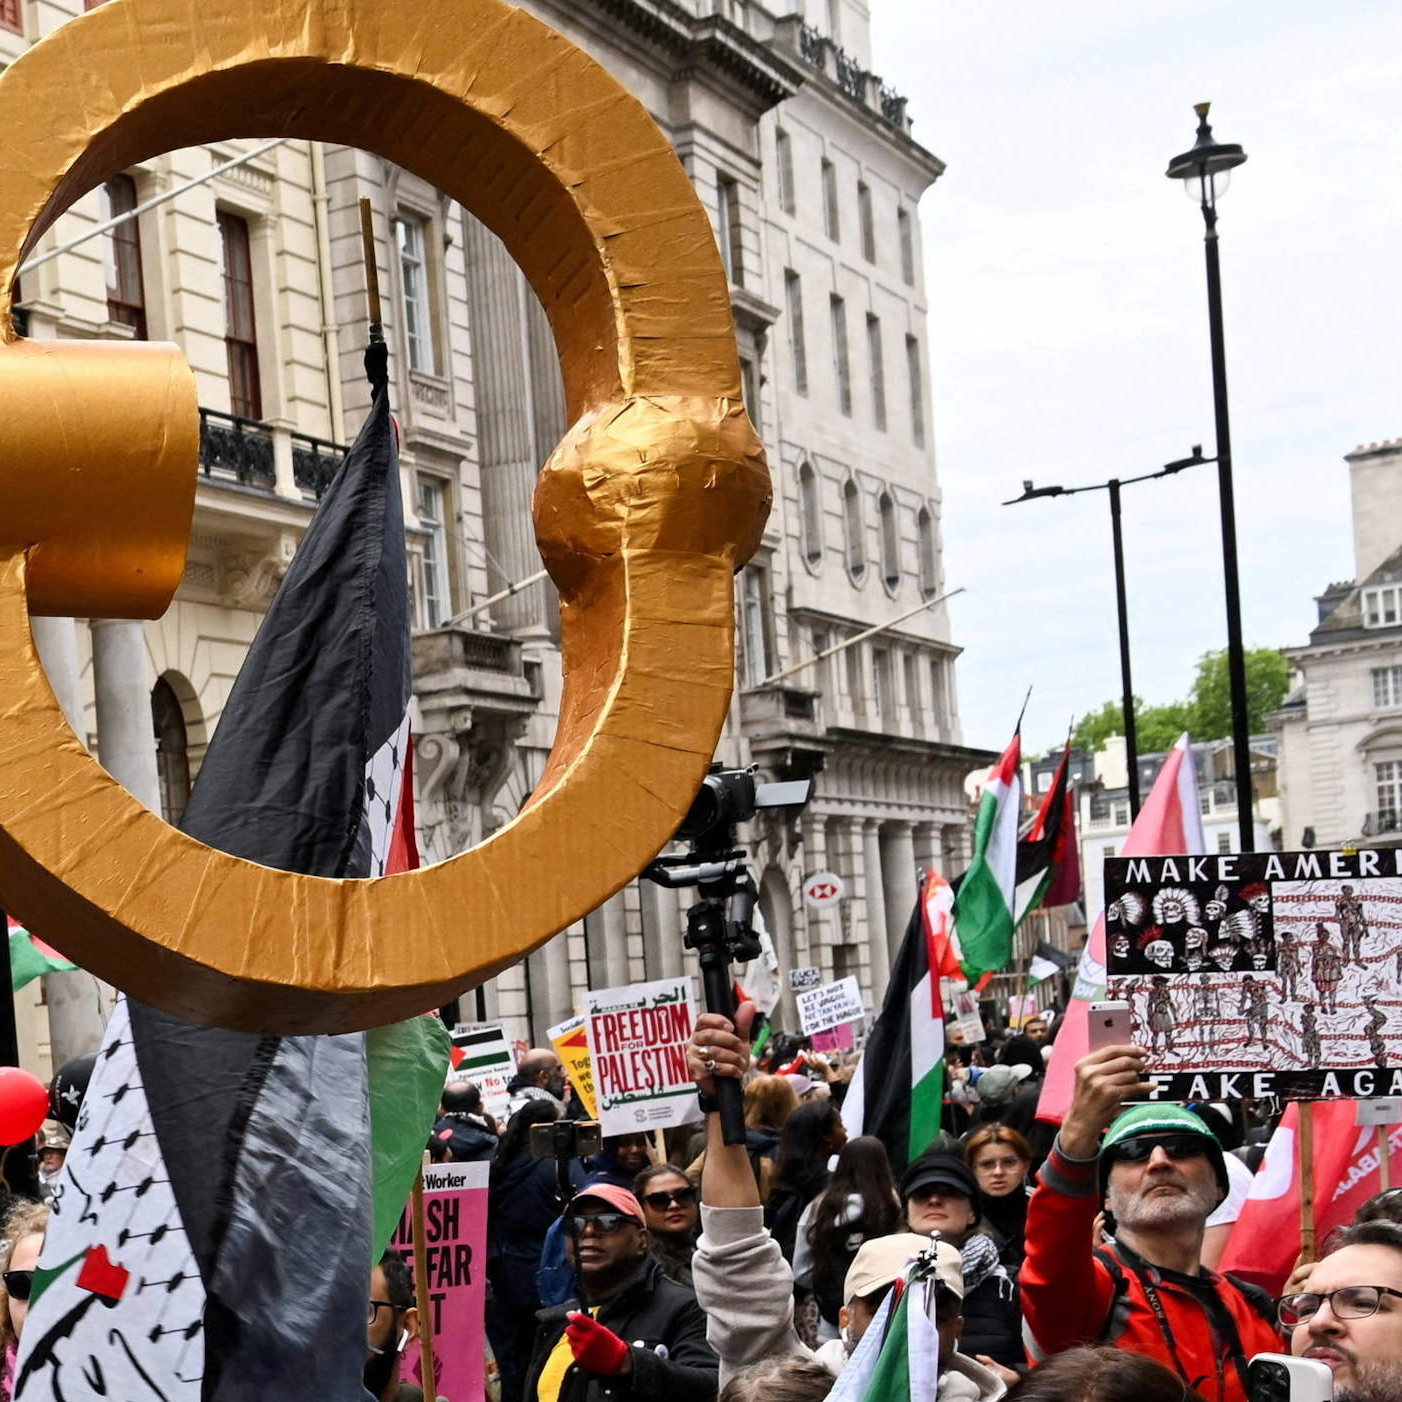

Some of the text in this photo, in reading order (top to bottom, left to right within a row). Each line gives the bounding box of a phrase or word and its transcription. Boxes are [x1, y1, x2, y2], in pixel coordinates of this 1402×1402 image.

[1125, 856, 1240, 884] MAKE
[591, 1002, 692, 1055] FREEDOM
[621, 1042, 644, 1051] FOR
[1149, 1074, 1276, 1101] FAKE
[426, 1174, 467, 1190] Worker
[426, 1244, 473, 1290] FAR
